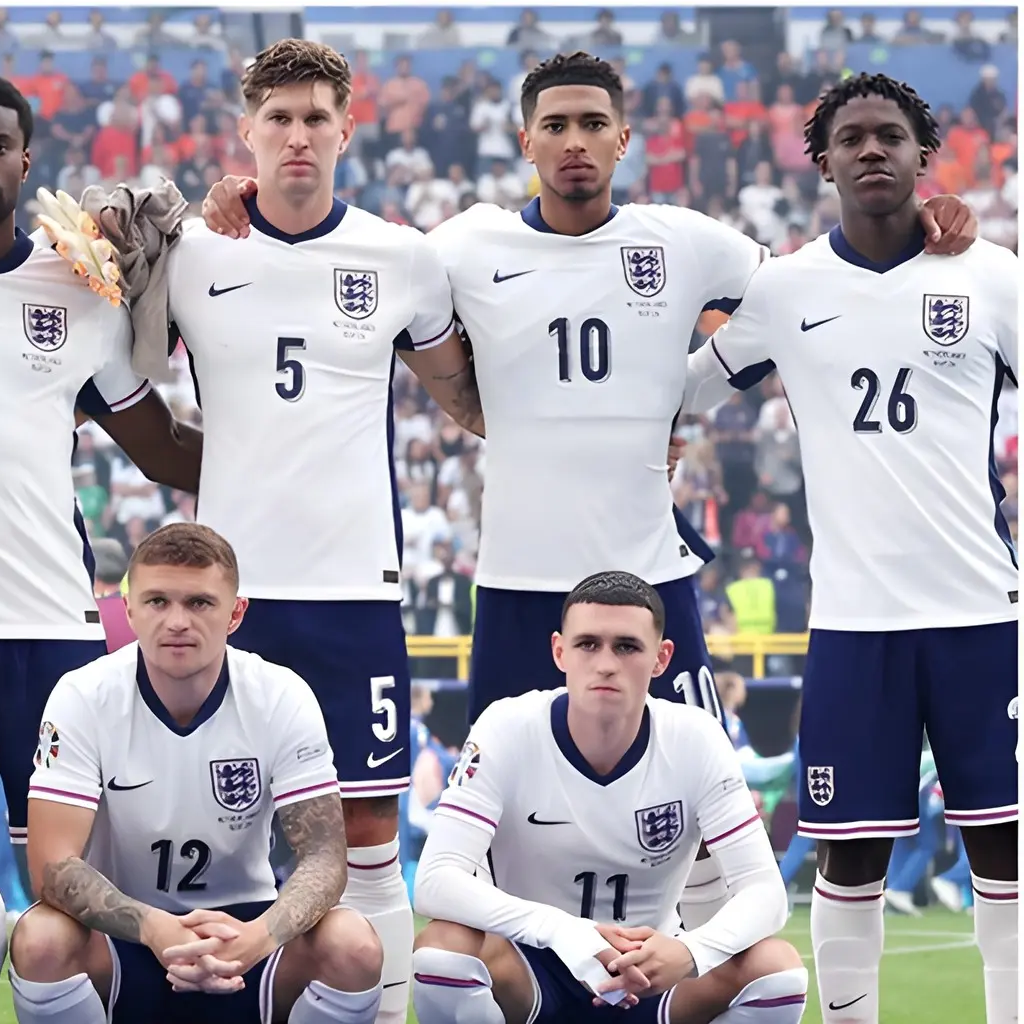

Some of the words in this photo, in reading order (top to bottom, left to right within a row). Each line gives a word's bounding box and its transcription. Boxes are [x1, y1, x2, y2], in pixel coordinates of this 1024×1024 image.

[276, 337, 306, 402] 5
[549, 318, 611, 383] 10
[851, 368, 918, 433] 26
[370, 676, 396, 742] 5
[151, 839, 211, 893] 12
[573, 872, 629, 921] 11
